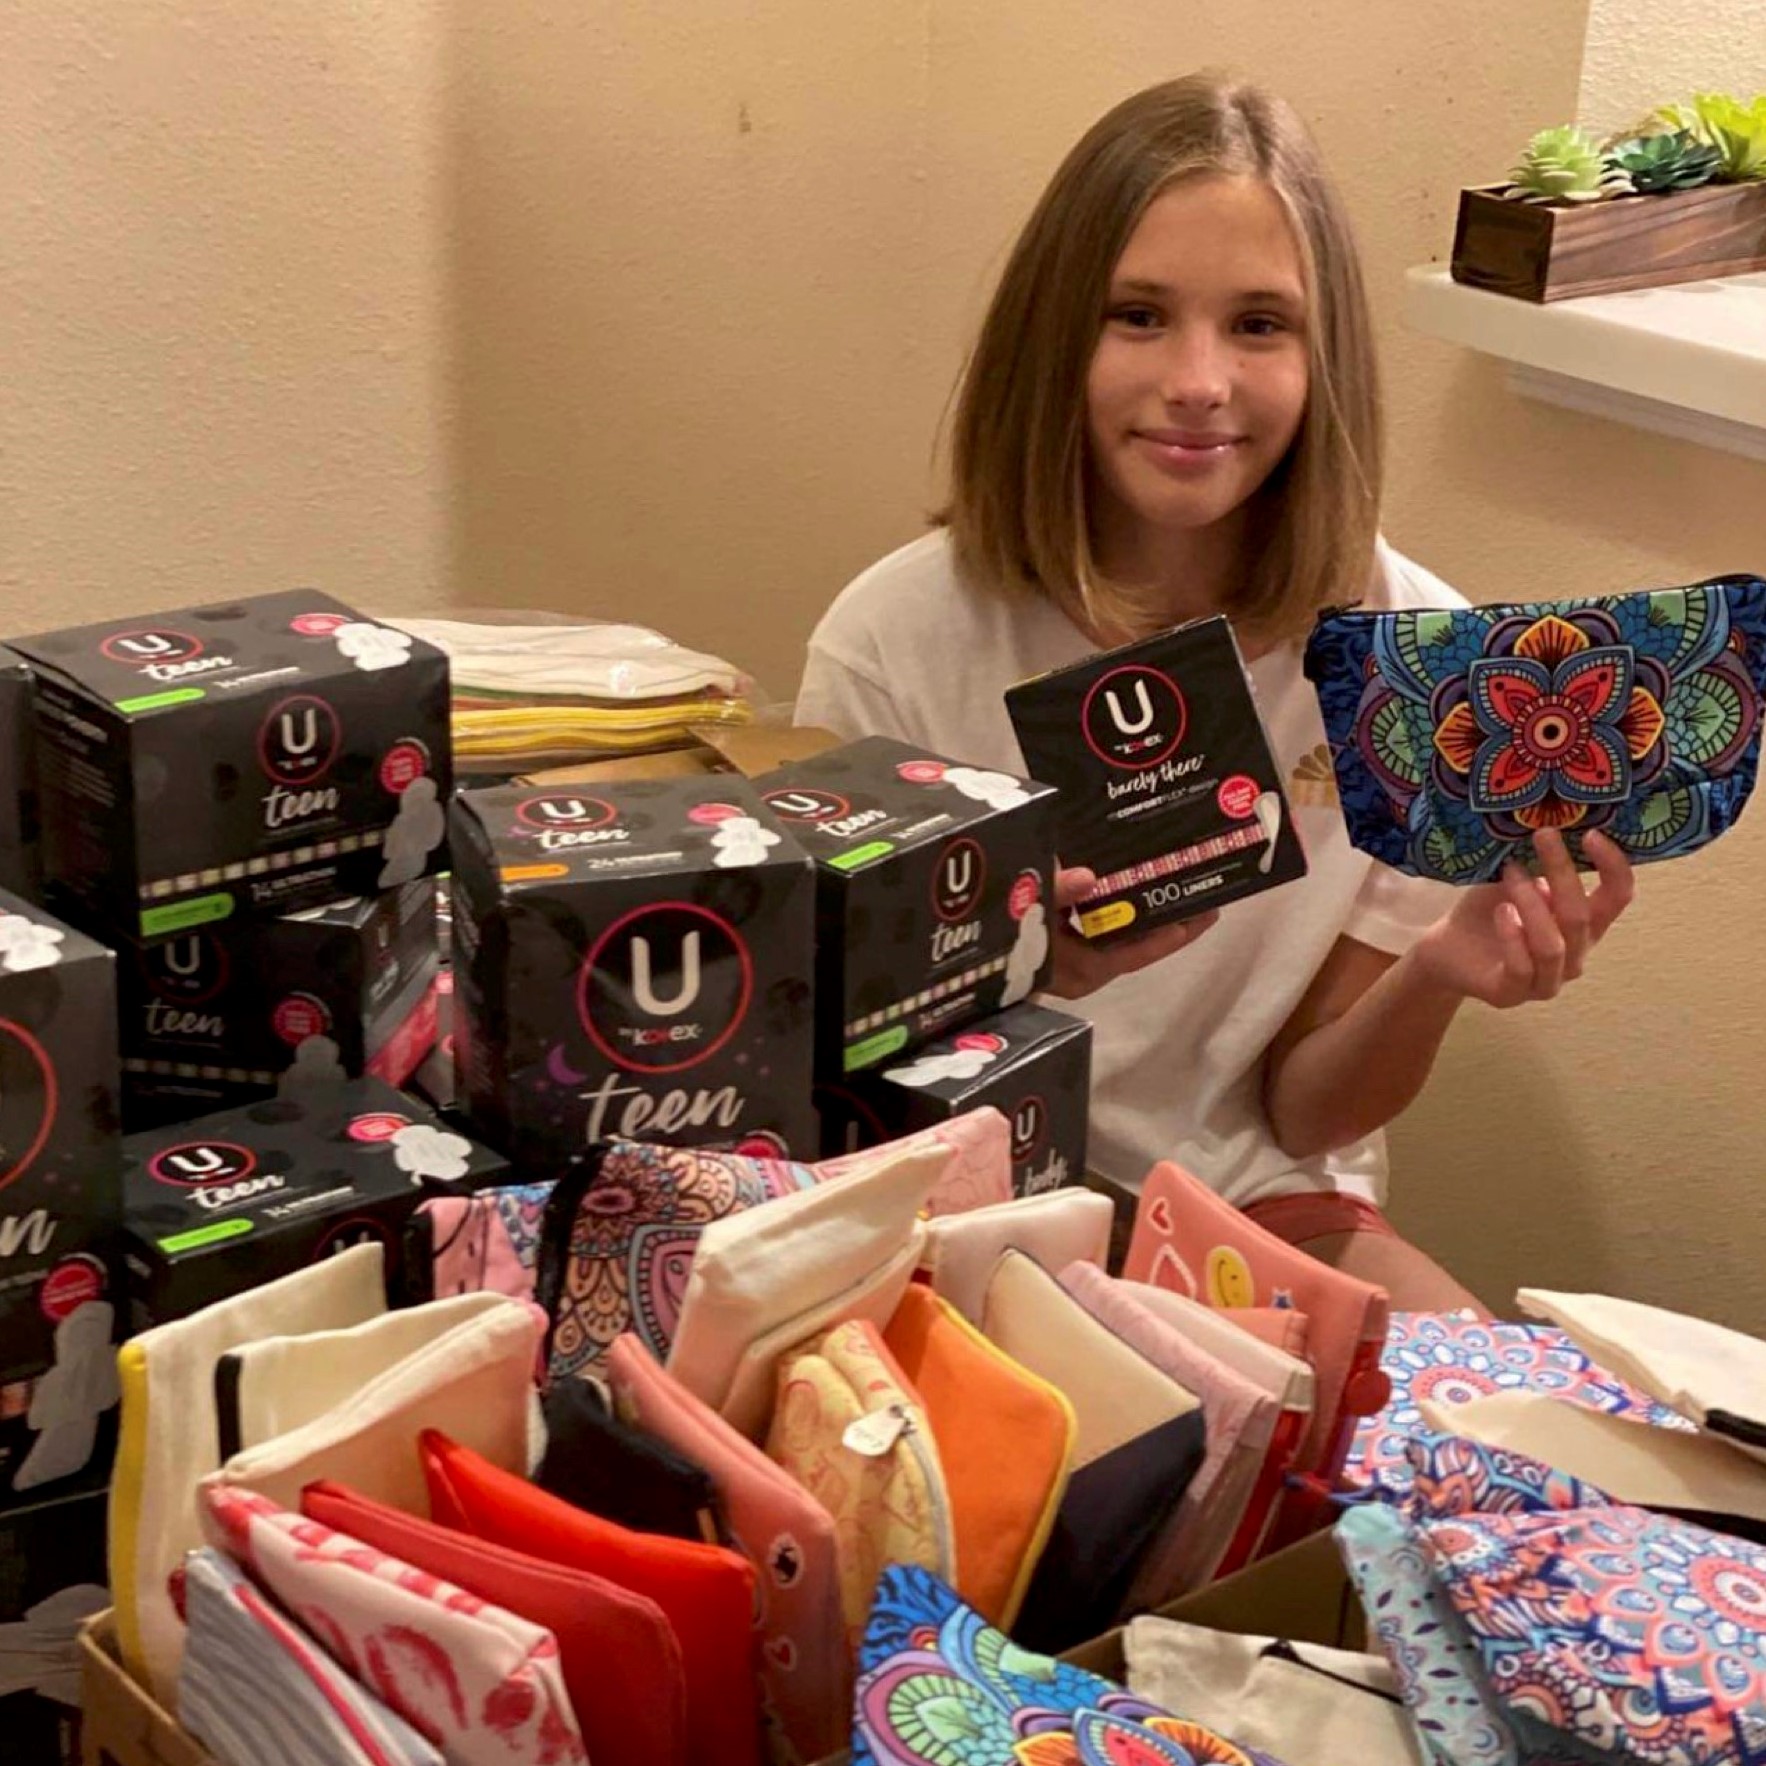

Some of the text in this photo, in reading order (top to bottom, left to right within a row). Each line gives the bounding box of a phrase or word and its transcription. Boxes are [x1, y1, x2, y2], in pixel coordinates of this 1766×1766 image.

[117, 635, 172, 653] U
[138, 656, 233, 680] teen
[1105, 678, 1154, 734] U
[281, 709, 317, 754] U
[261, 785, 339, 827] teen
[539, 800, 587, 820] U
[770, 793, 820, 813] U
[533, 829, 630, 849] teen
[947, 850, 971, 893] U
[1142, 882, 1180, 908] 100
[165, 935, 200, 974] U
[631, 930, 700, 1016] U
[143, 997, 226, 1037] teen
[578, 1072, 745, 1144] teen
[1016, 1105, 1036, 1142] U
[169, 1148, 222, 1173] U
[187, 1173, 286, 1209] teen
